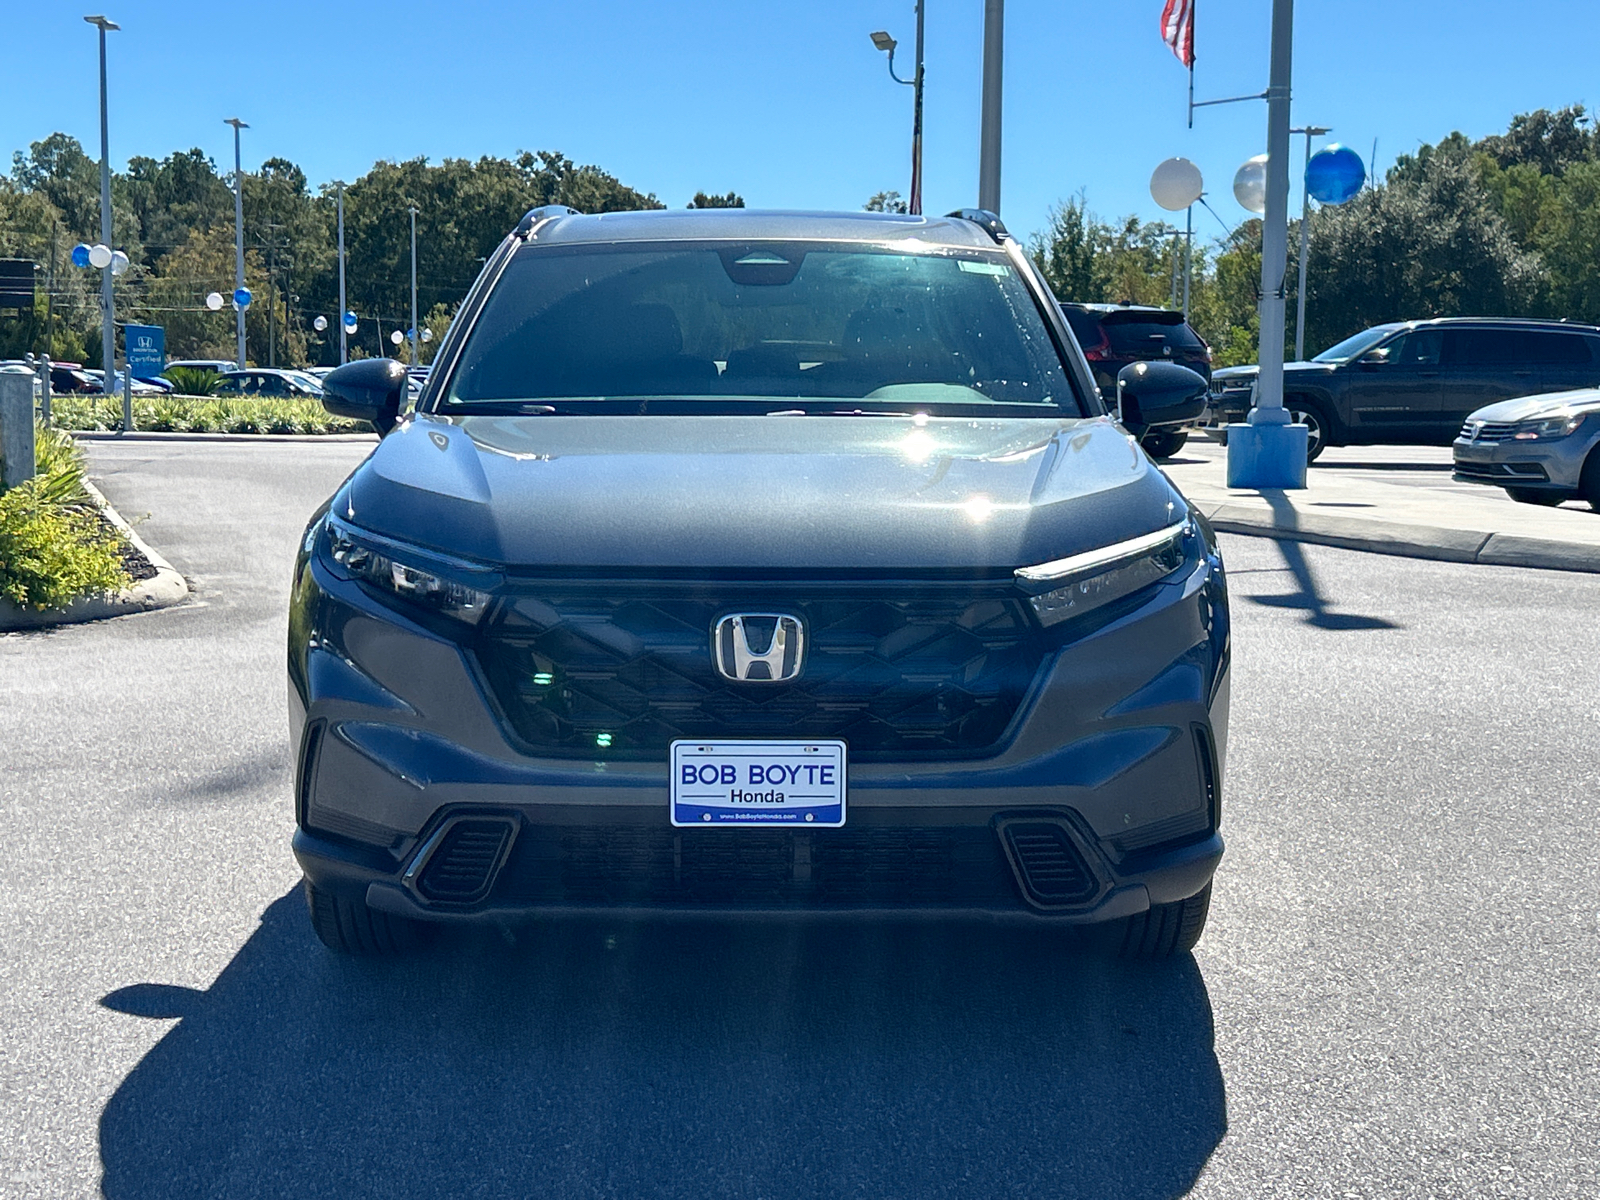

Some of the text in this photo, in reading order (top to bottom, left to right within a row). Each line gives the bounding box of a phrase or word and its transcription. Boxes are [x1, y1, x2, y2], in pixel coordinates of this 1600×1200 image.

[681, 764, 836, 785] BOB BOYTE
[730, 789, 785, 804] Honda
